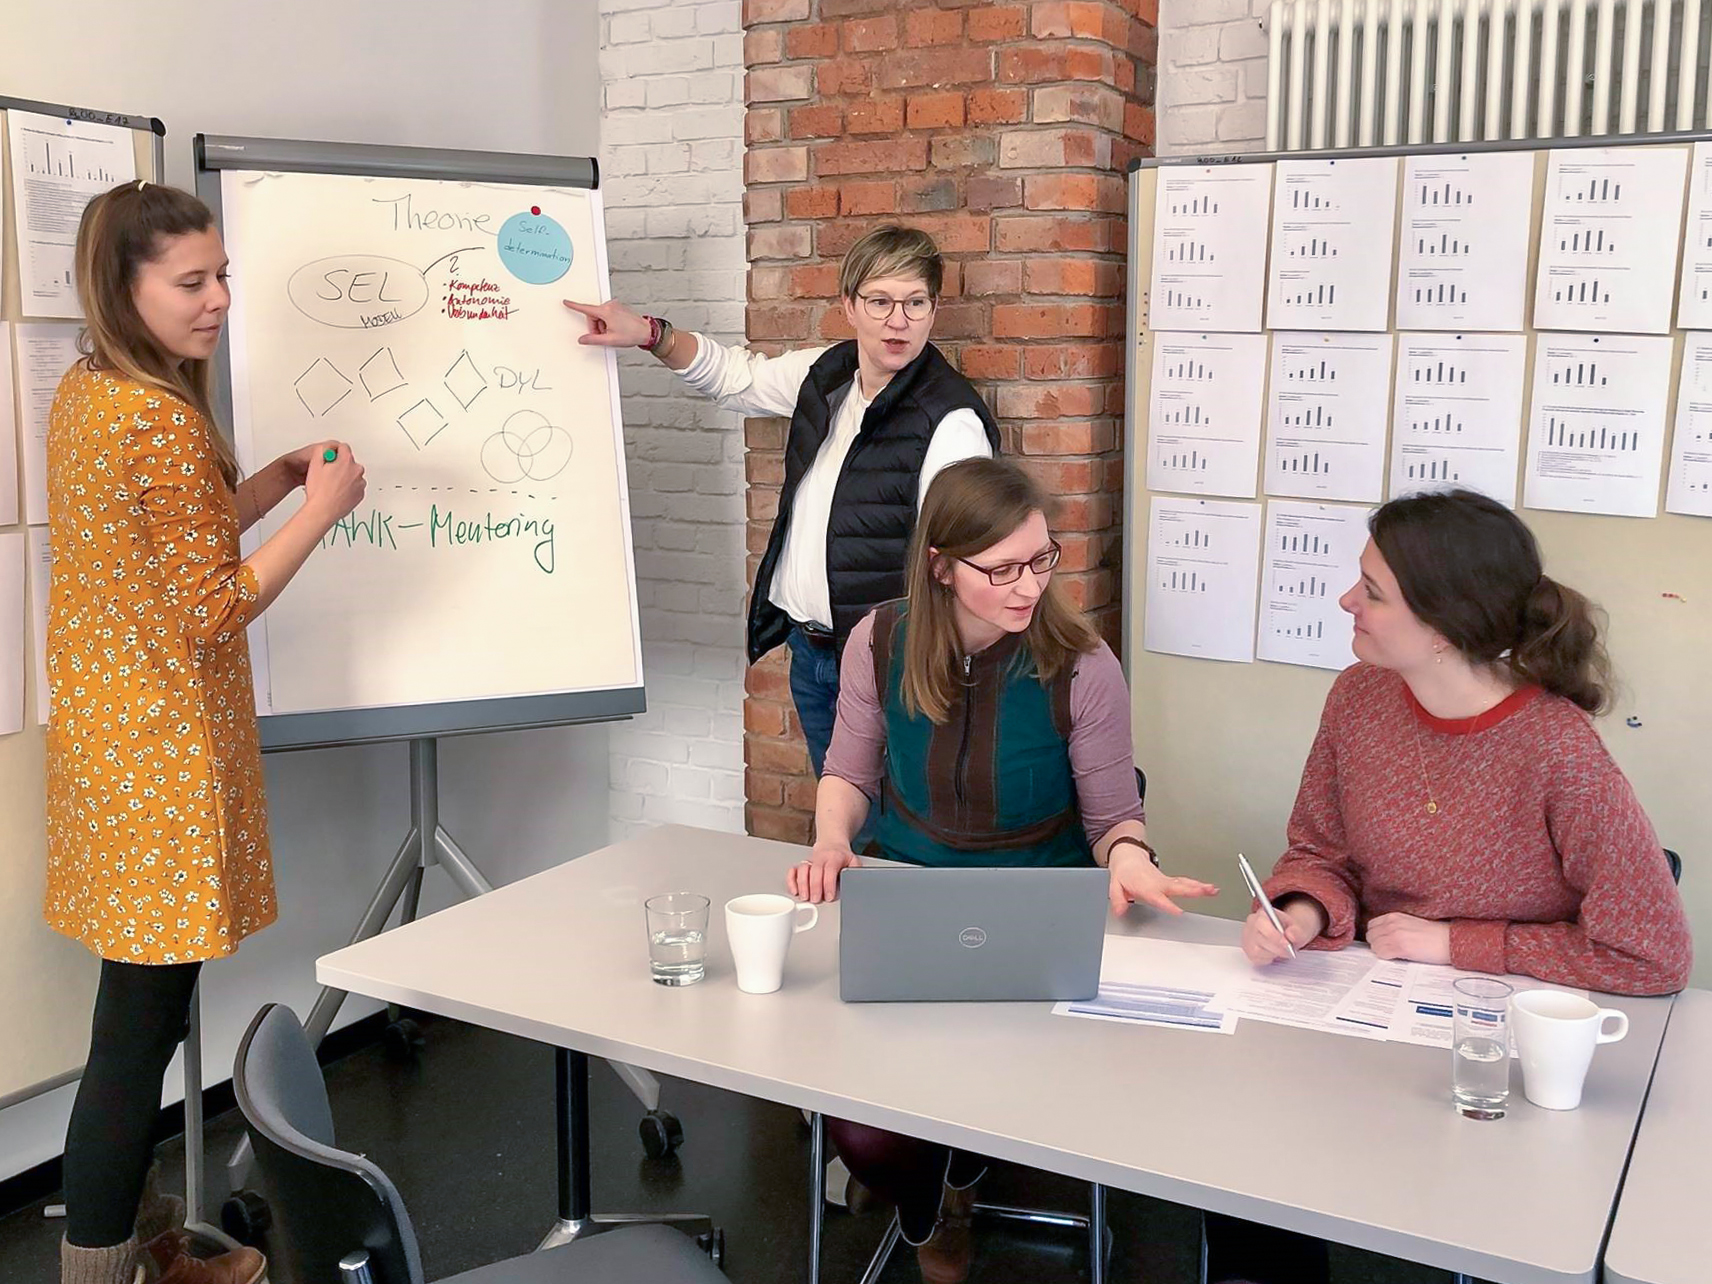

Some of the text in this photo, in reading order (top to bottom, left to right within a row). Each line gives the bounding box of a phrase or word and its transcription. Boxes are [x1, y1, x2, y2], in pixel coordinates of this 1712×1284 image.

[372, 194, 499, 236] Theorie
[519, 220, 550, 236] Self-
[503, 237, 571, 264] determination
[316, 268, 402, 303] SEL
[494, 366, 552, 394] DYL
[321, 504, 554, 573] AWK-Mentoring
